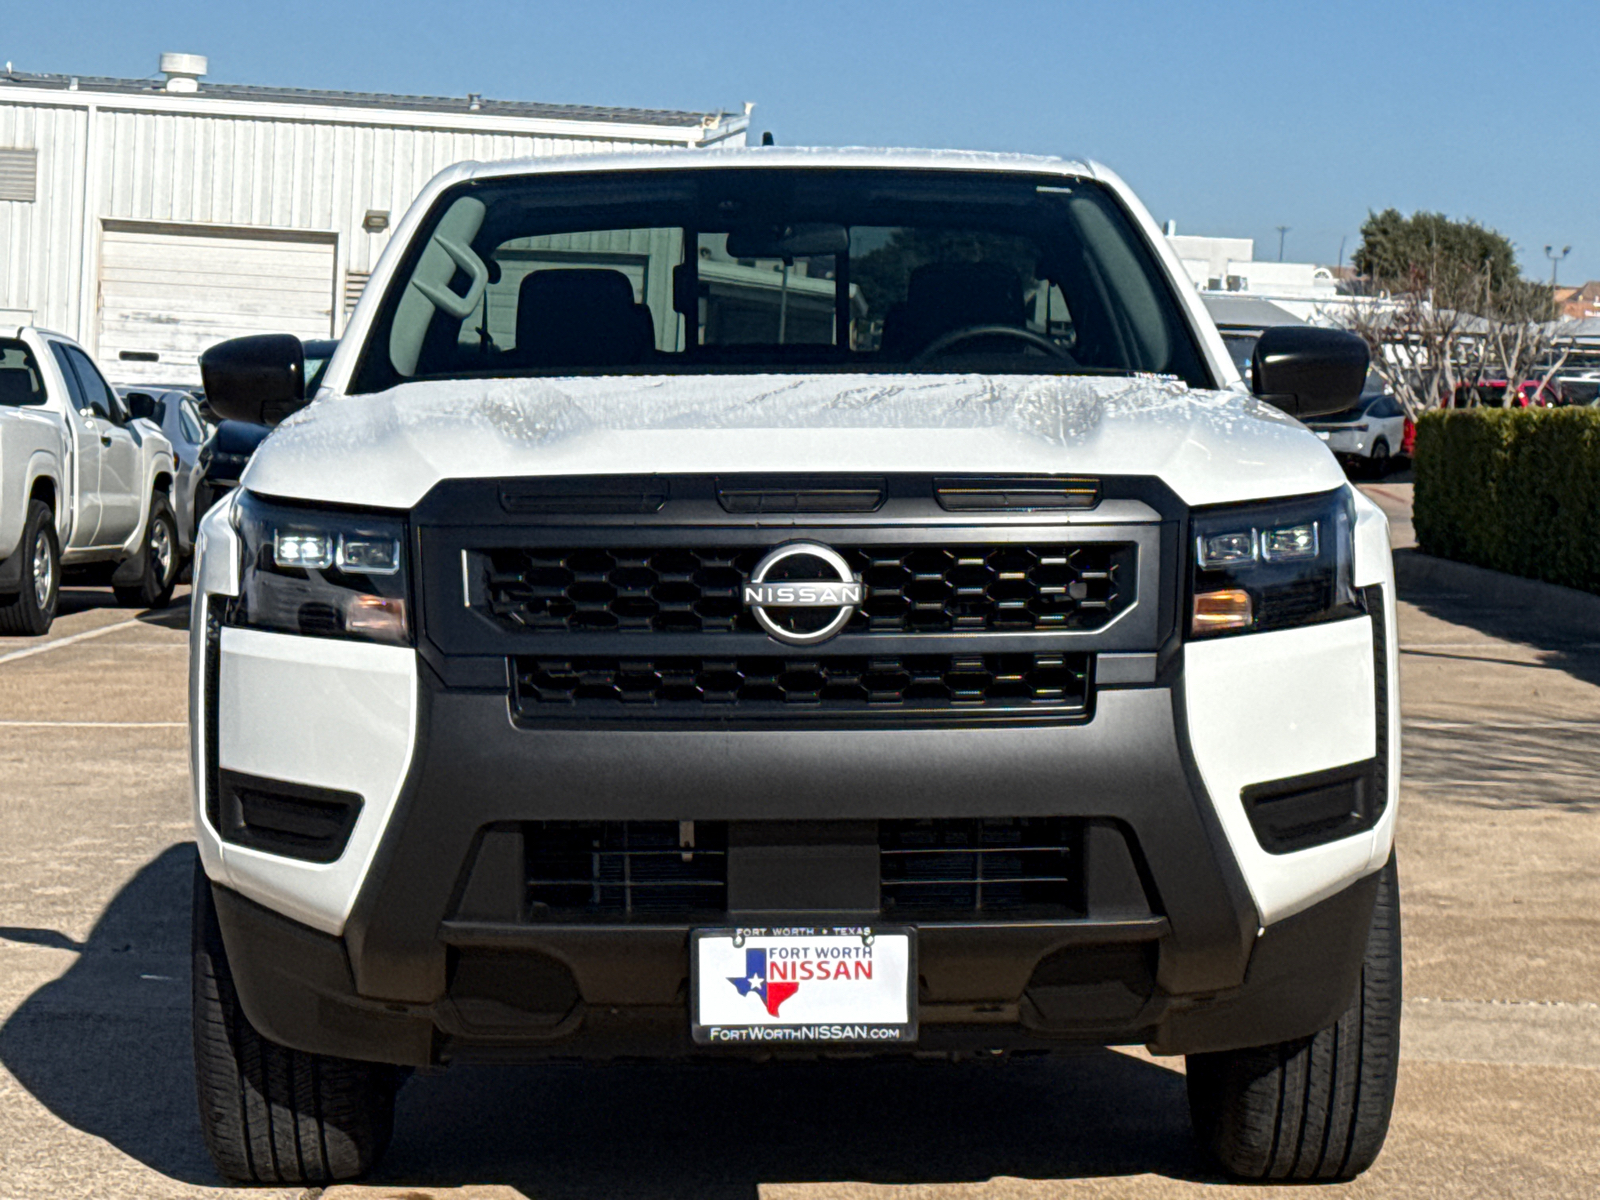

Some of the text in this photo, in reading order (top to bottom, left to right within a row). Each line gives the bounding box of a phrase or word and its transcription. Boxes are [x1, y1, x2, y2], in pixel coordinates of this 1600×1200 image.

[745, 587, 859, 602] NISSAN
[736, 926, 872, 937] FORT WORTH TEXAS
[769, 946, 873, 959] FORT WORTH
[769, 961, 873, 980] NISSAN
